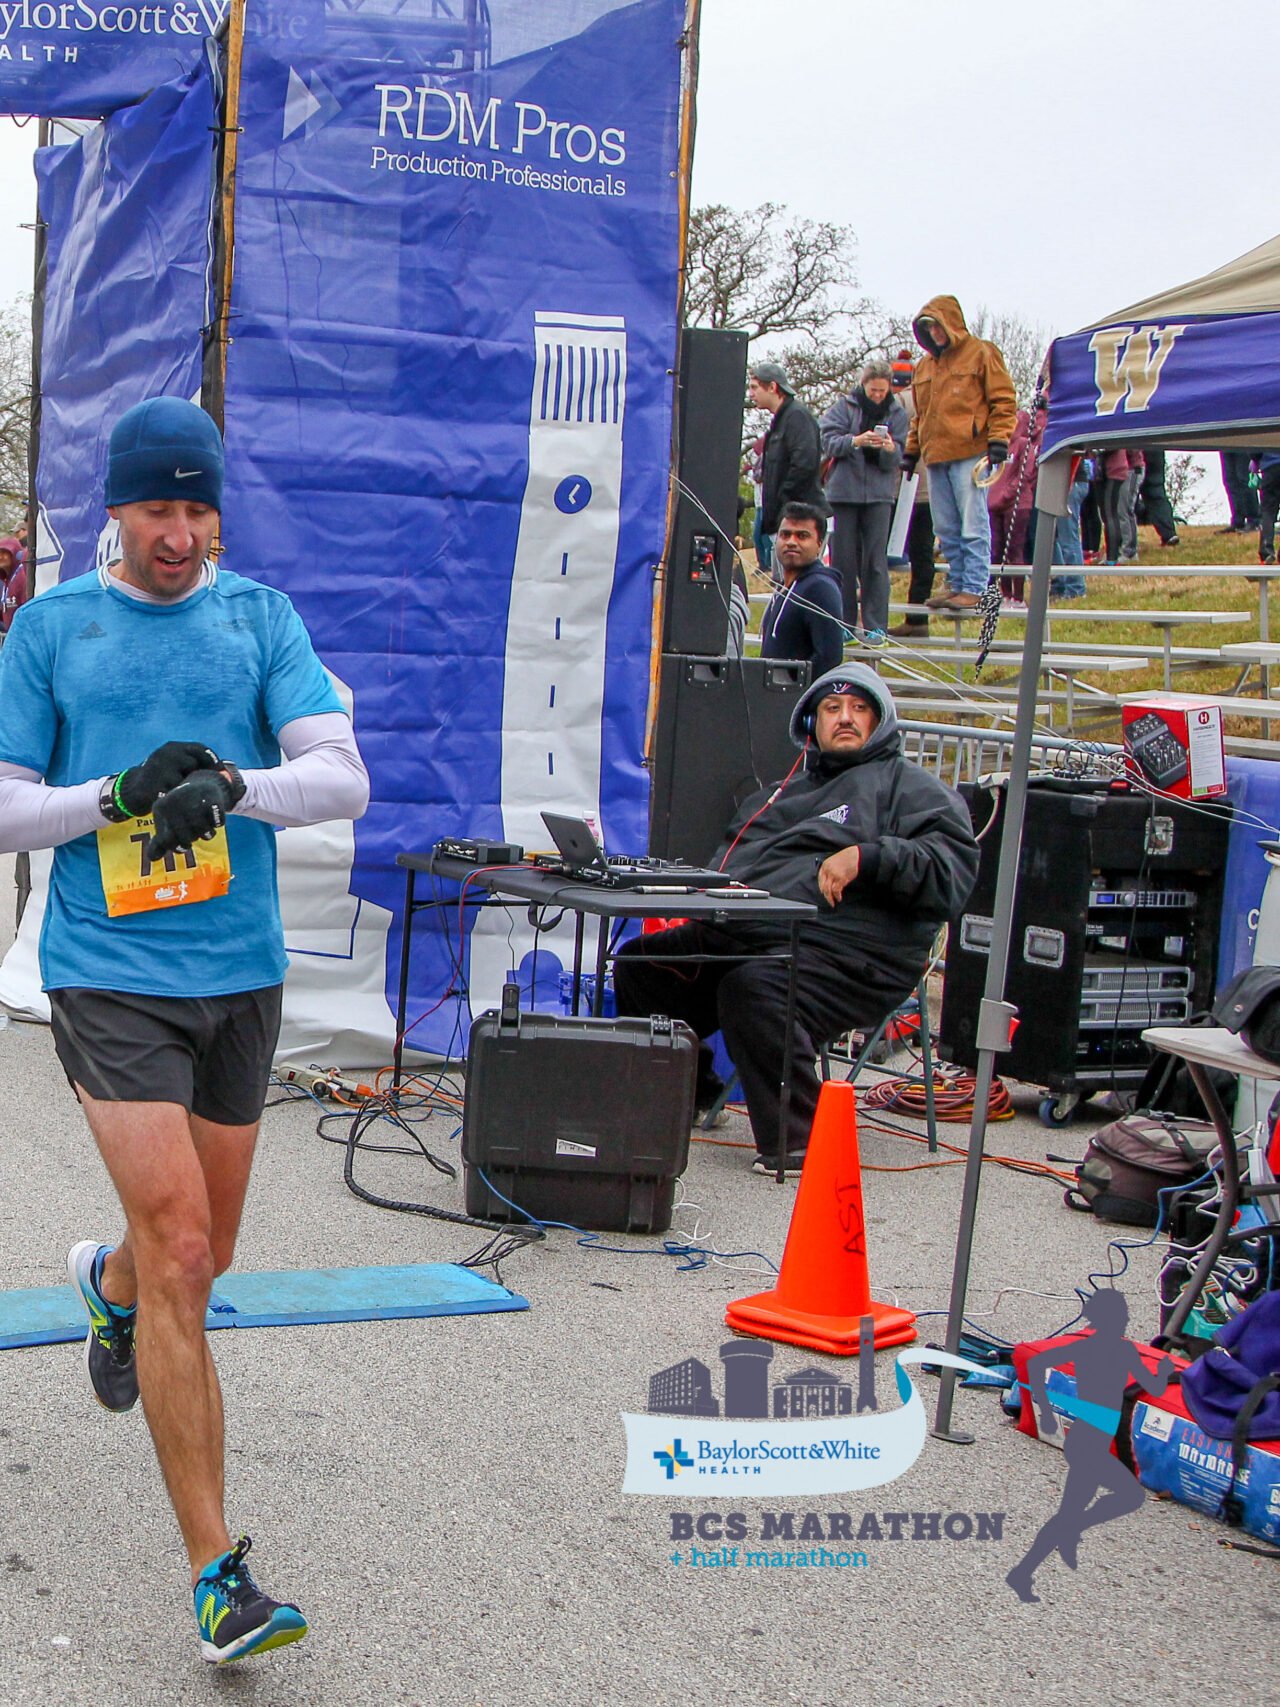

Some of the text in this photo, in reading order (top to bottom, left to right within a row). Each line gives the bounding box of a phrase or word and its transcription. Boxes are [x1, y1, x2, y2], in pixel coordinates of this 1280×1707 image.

[374, 84, 626, 165] RDM Pros
[370, 146, 626, 197] Production Professionals
[136, 818, 156, 828] Pau
